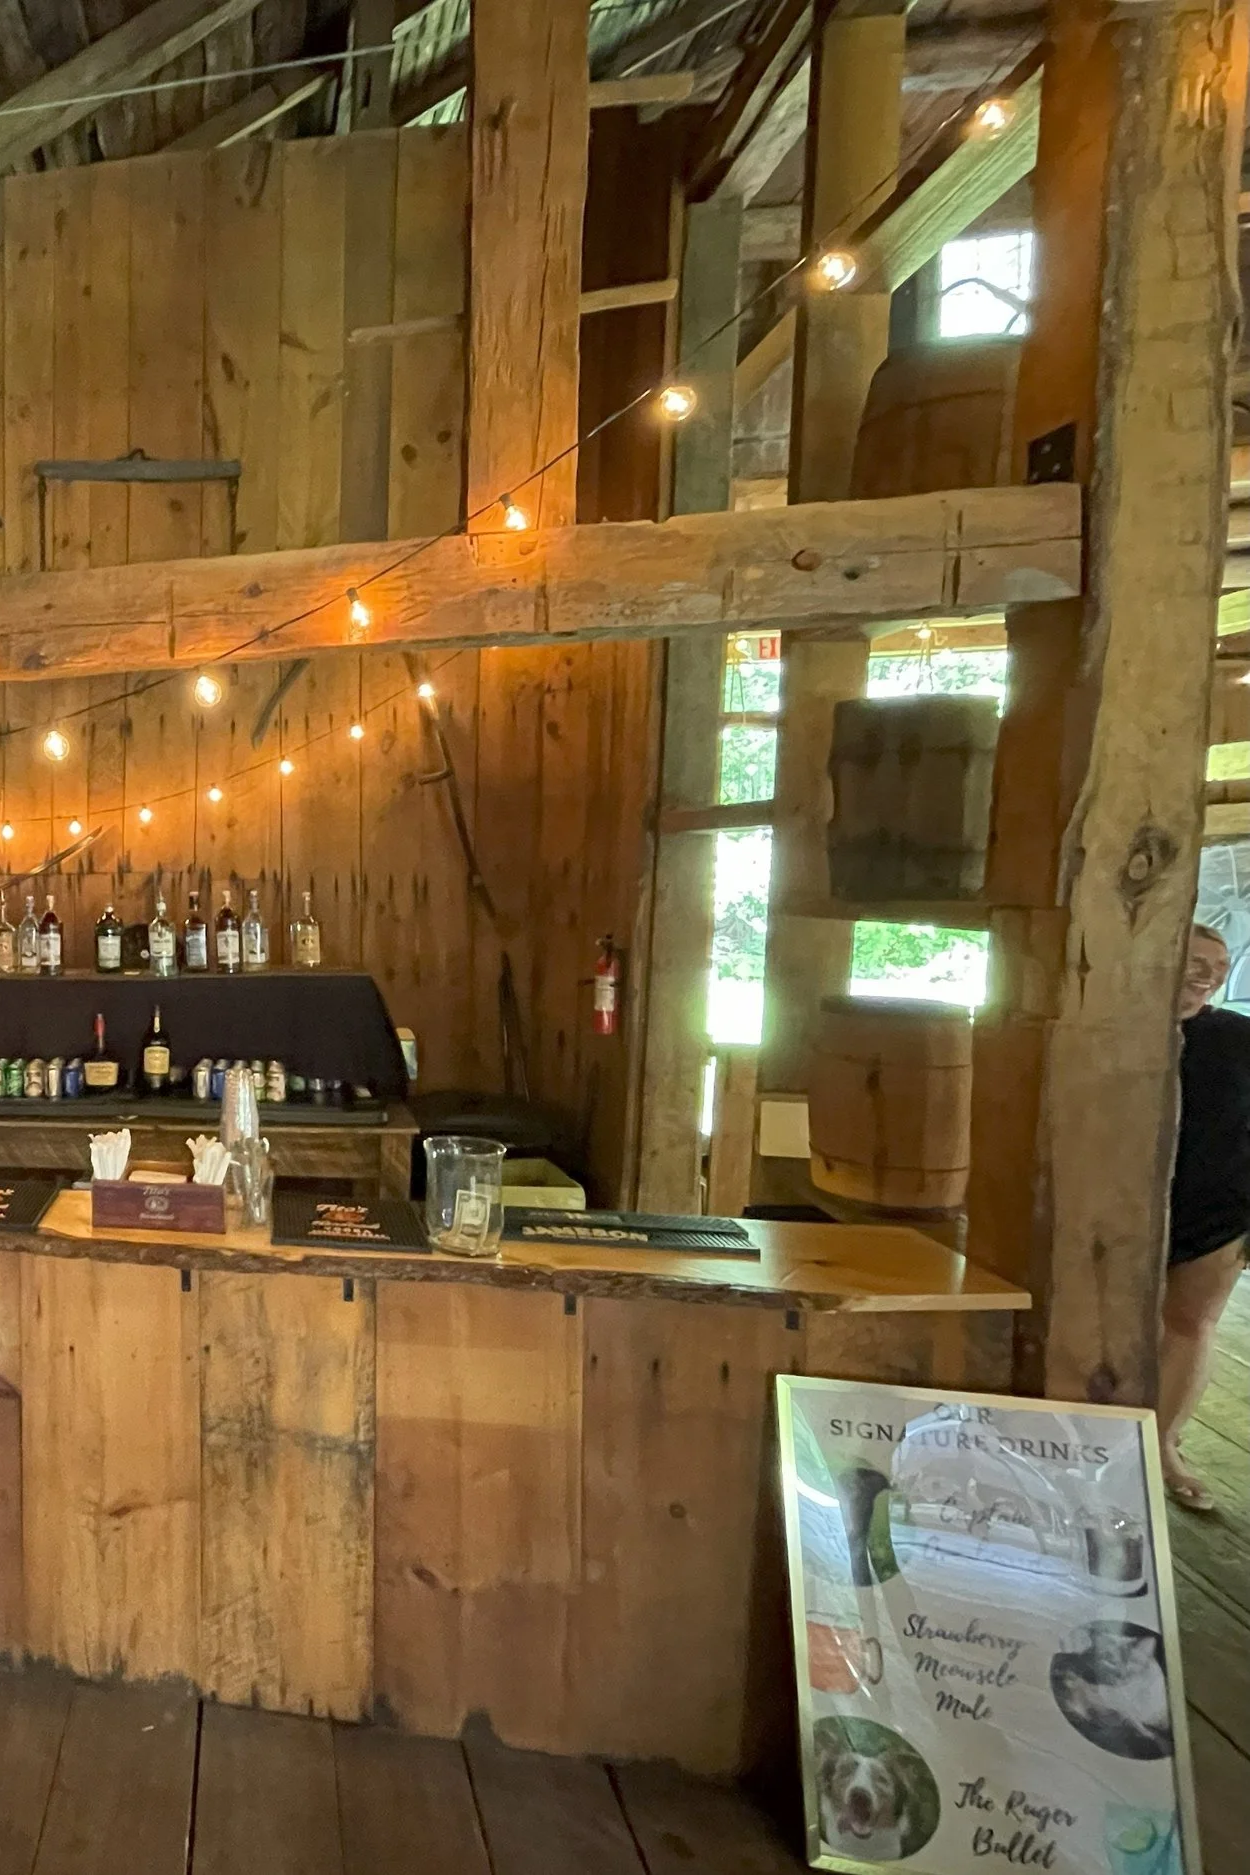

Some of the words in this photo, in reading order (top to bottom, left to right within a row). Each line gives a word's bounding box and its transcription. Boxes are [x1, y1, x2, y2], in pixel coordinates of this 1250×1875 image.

[933, 1401, 993, 1426] OUR
[830, 1418, 989, 1452] SIGNATURE
[997, 1435, 1111, 1466] DRINKS
[903, 1613, 1028, 1661] Strawberry
[935, 1690, 993, 1721] Mule
[954, 1776, 996, 1813] The
[1004, 1789, 1079, 1833] Ruger
[972, 1826, 1057, 1870] Bullet
